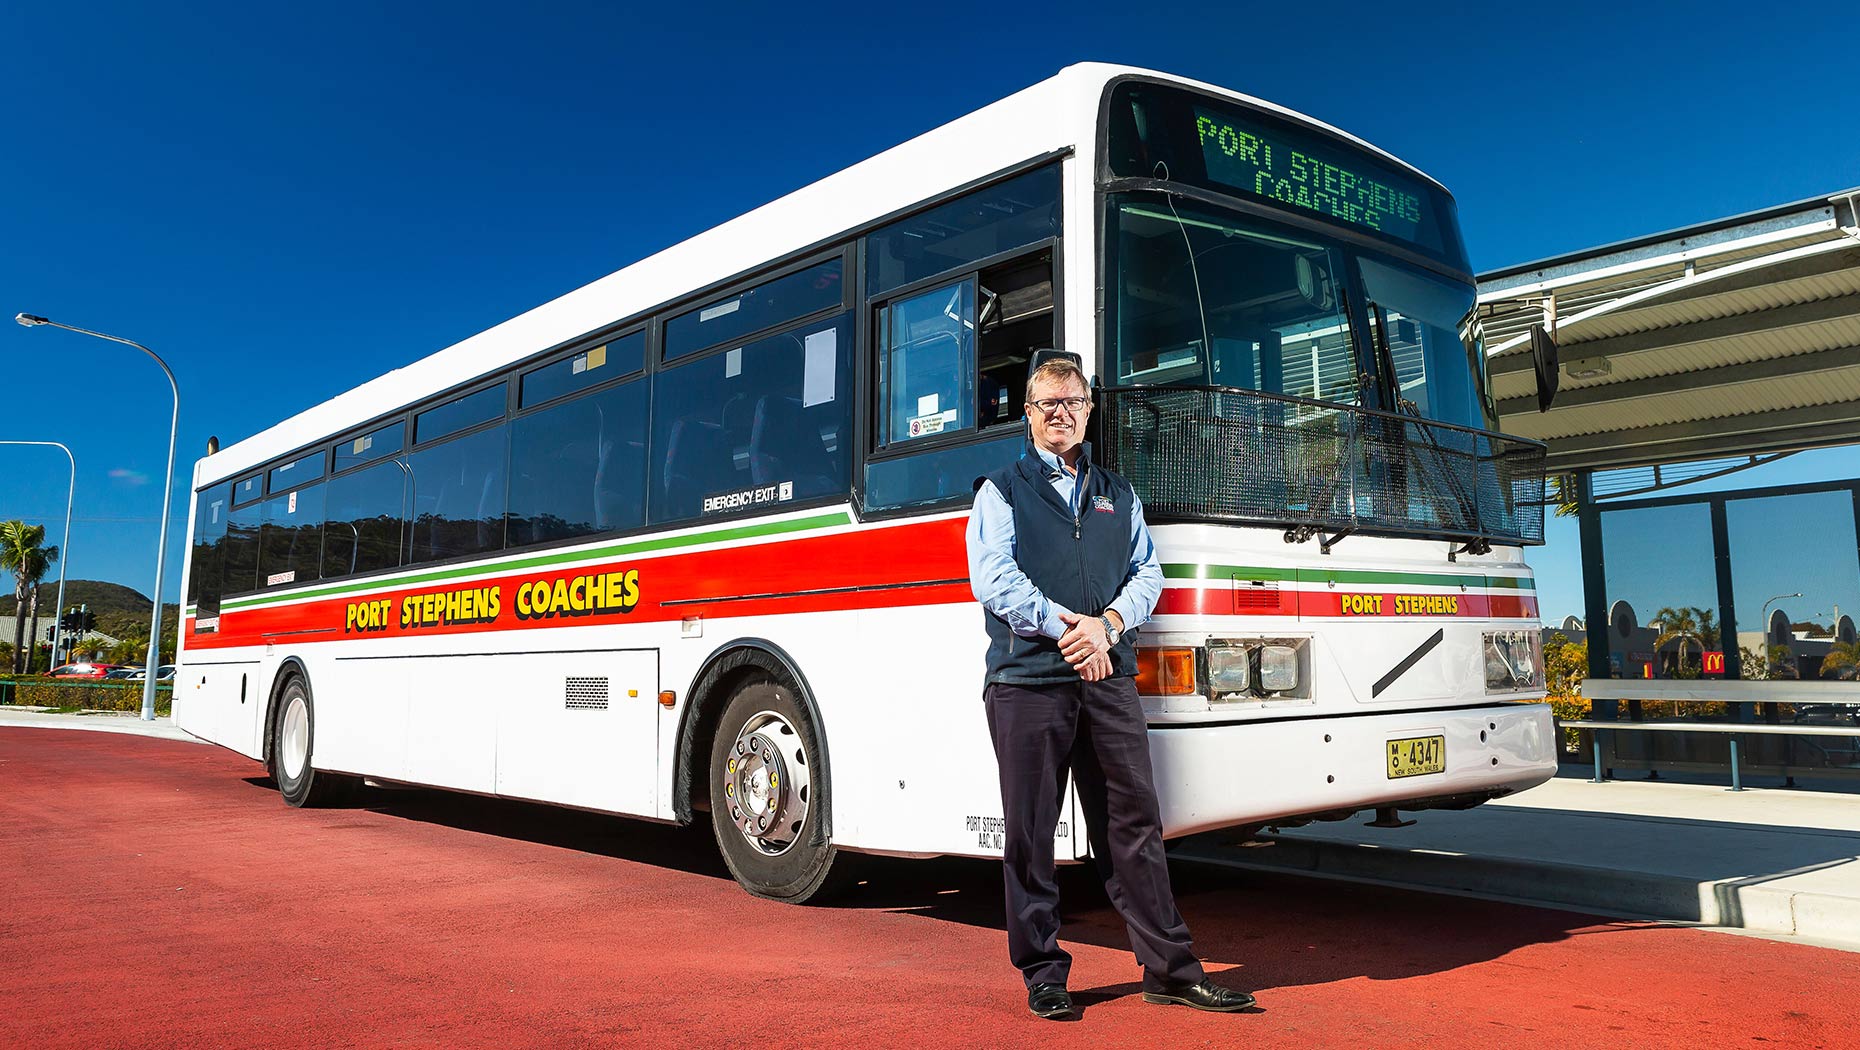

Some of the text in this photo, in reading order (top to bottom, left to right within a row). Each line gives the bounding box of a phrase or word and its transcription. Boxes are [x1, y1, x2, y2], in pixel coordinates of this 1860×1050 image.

[1197, 116, 1421, 223] PORT STEPHENS
[704, 486, 776, 511] EMERGENCY EXIT
[345, 569, 643, 633] PORT STEPHENS COACHES
[1341, 594, 1458, 615] PORT STEPHENS
[1409, 739, 1439, 766] 4347
[966, 816, 981, 832] PORT
[982, 816, 1005, 834] STEPHE
